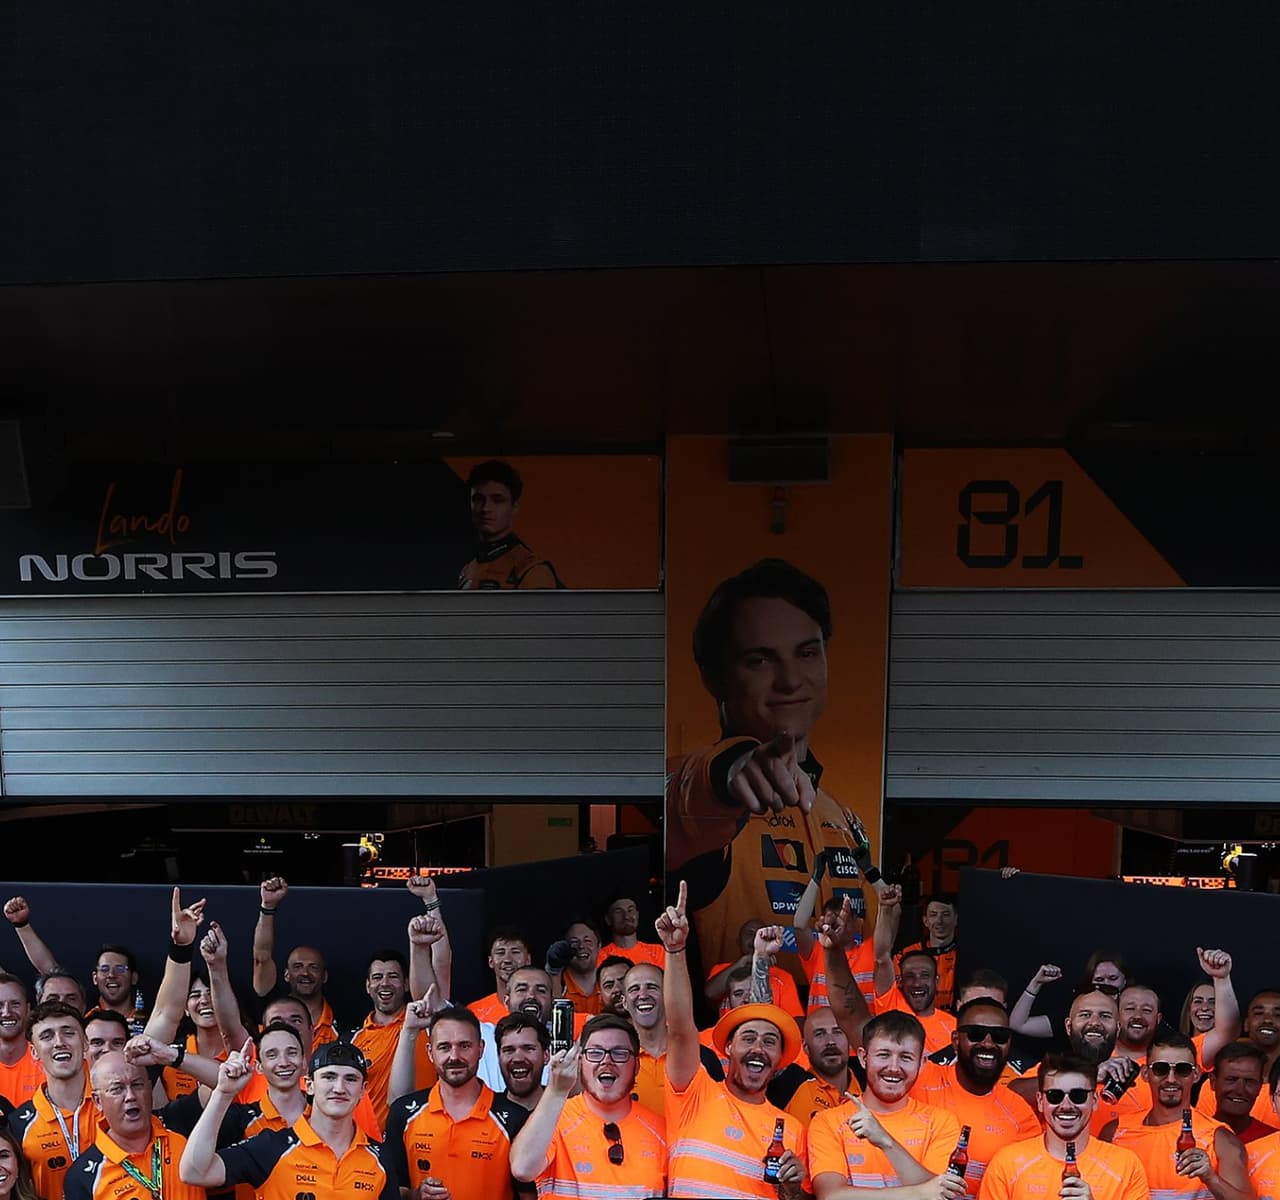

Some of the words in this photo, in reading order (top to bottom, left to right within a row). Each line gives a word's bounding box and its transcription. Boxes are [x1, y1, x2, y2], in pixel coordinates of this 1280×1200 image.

[95, 469, 191, 555] Lando
[956, 479, 1084, 570] 81
[19, 551, 278, 582] NORRIS
